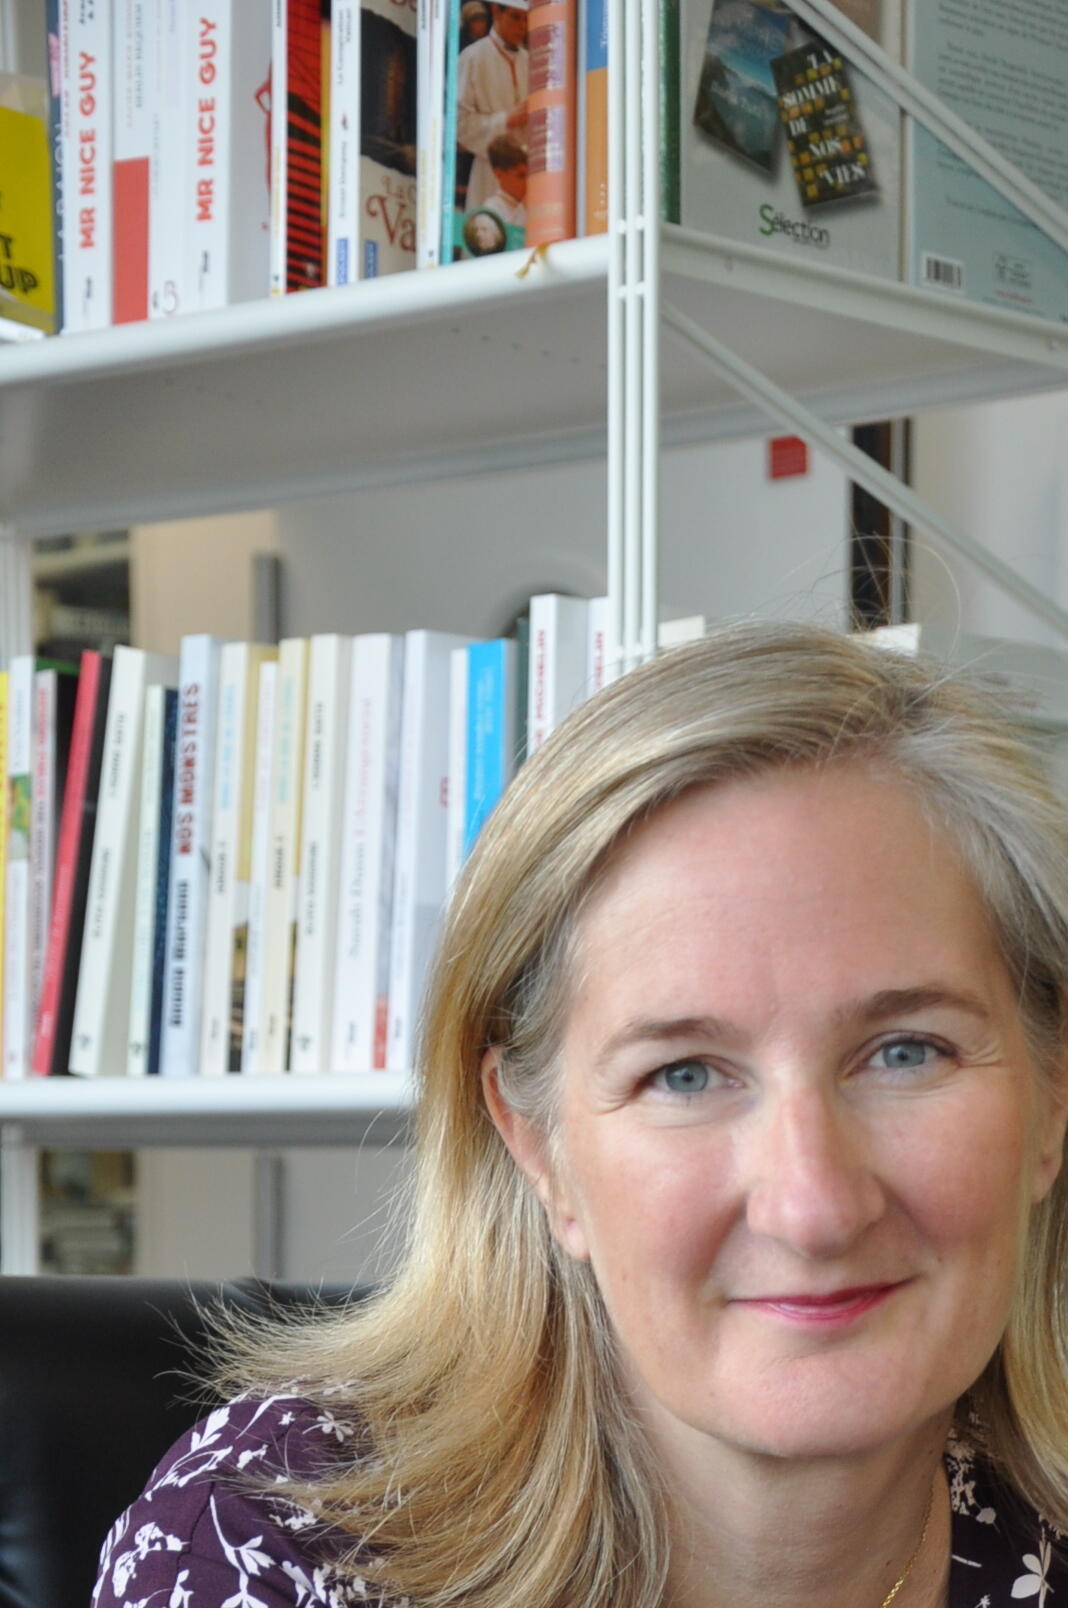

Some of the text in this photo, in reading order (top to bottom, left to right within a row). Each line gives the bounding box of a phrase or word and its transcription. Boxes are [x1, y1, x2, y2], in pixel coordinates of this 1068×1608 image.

[79, 50, 97, 250] MR NICE GUY
[196, 17, 217, 222] MR NICE GUY
[820, 162, 866, 186] VIES
[179, 682, 201, 806] MONSTRES
[176, 810, 194, 855] NOS
